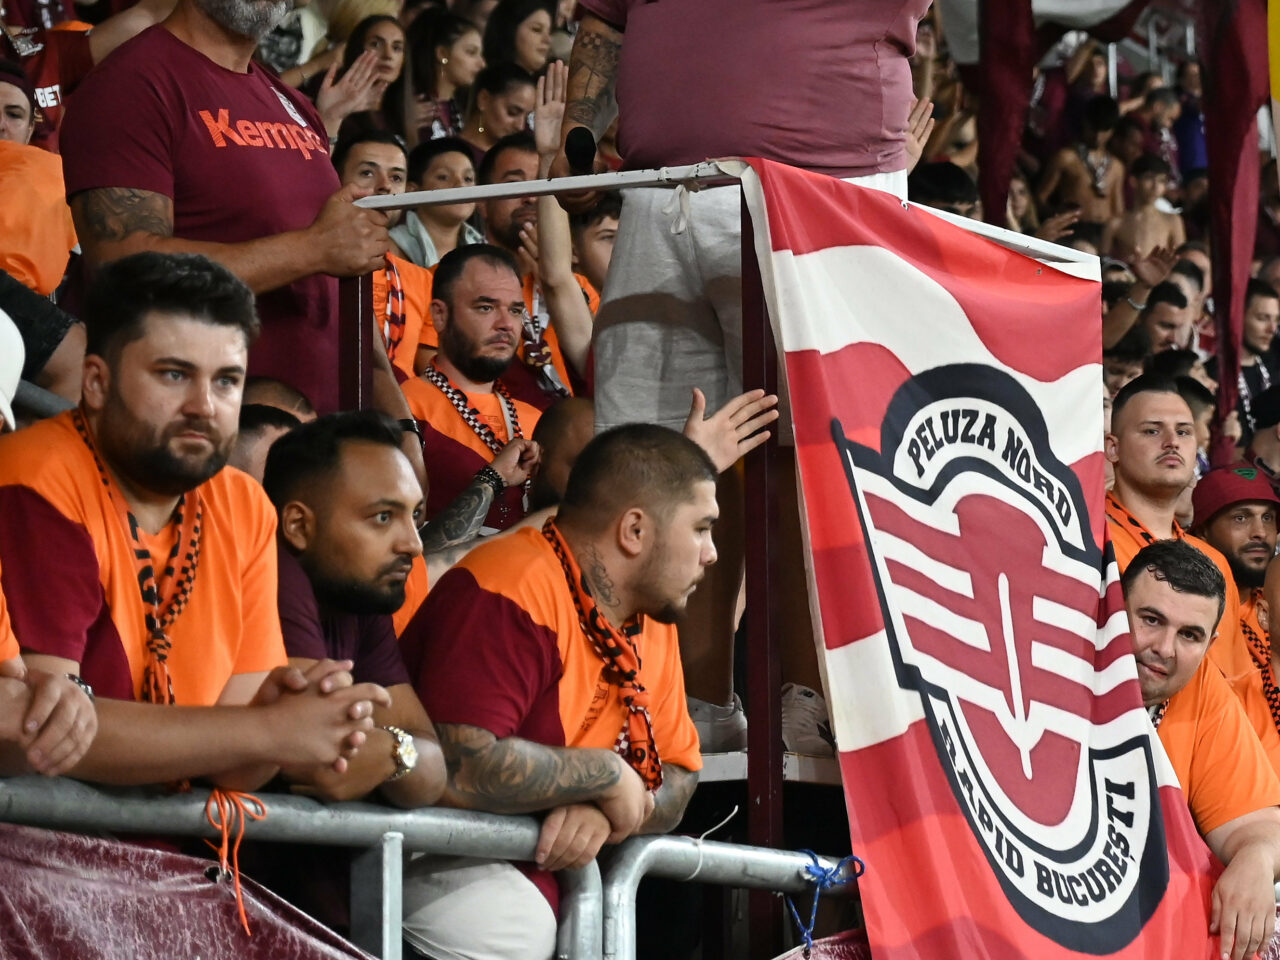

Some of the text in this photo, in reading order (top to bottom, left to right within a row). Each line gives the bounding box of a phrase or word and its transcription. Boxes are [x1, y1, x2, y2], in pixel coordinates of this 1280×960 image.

[907, 408, 1072, 528] PELUZA NORD
[940, 718, 1025, 878] RAPID
